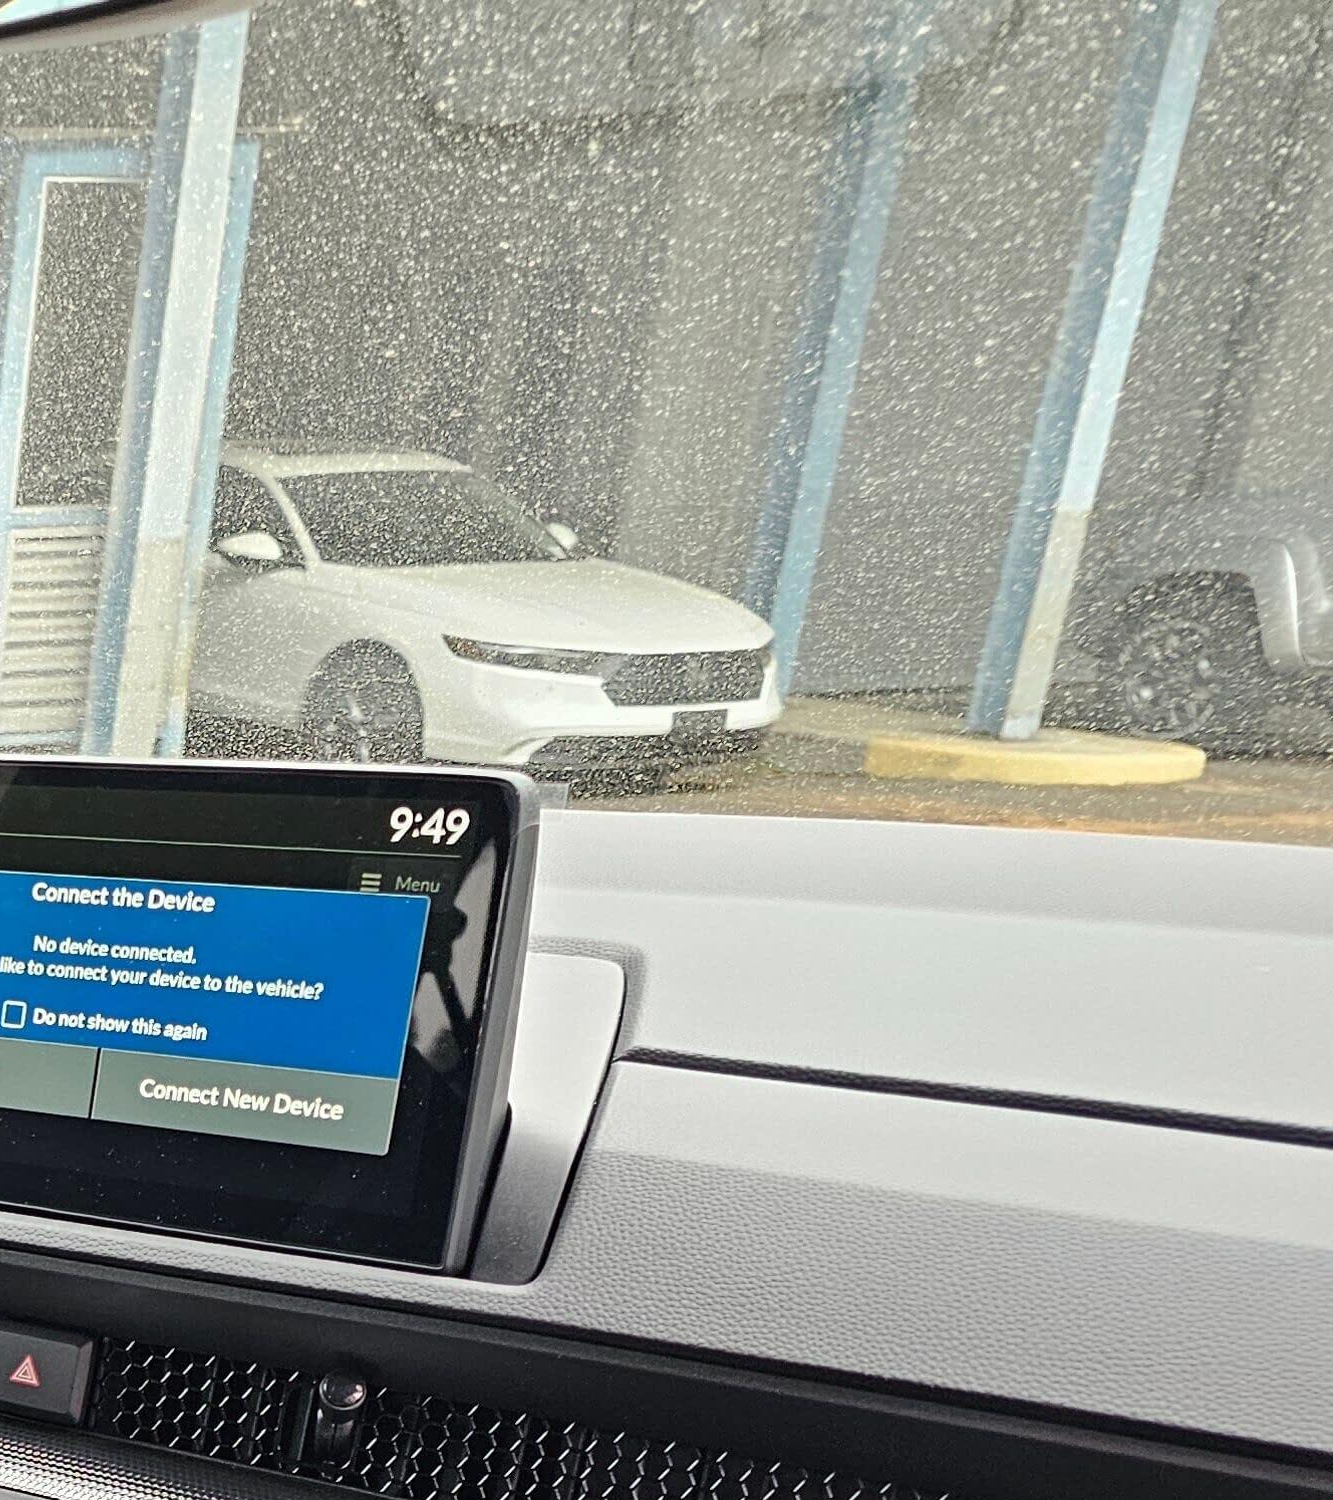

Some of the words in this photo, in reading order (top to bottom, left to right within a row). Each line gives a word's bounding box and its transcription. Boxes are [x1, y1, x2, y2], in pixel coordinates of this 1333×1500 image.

[390, 806, 470, 845] 9:49
[32, 881, 109, 906] Connect
[112, 886, 144, 908] the
[147, 888, 215, 912] Device
[394, 875, 440, 893] Menu
[33, 935, 57, 953] No
[59, 936, 110, 957] device
[111, 943, 197, 964] connected.
[0, 956, 25, 975] like
[27, 960, 45, 976] to
[46, 964, 108, 982] connect
[110, 968, 148, 986] your
[149, 968, 202, 990] device
[203, 974, 222, 992] to
[225, 975, 254, 995] the
[256, 979, 325, 1001] vehicle?
[32, 1008, 56, 1026] Do
[58, 1013, 86, 1029] not
[87, 1013, 130, 1033] show
[132, 1017, 162, 1036] this
[163, 1022, 208, 1041] again
[139, 1078, 219, 1107] Connect
[223, 1087, 270, 1113] New
[273, 1092, 344, 1121] Device
